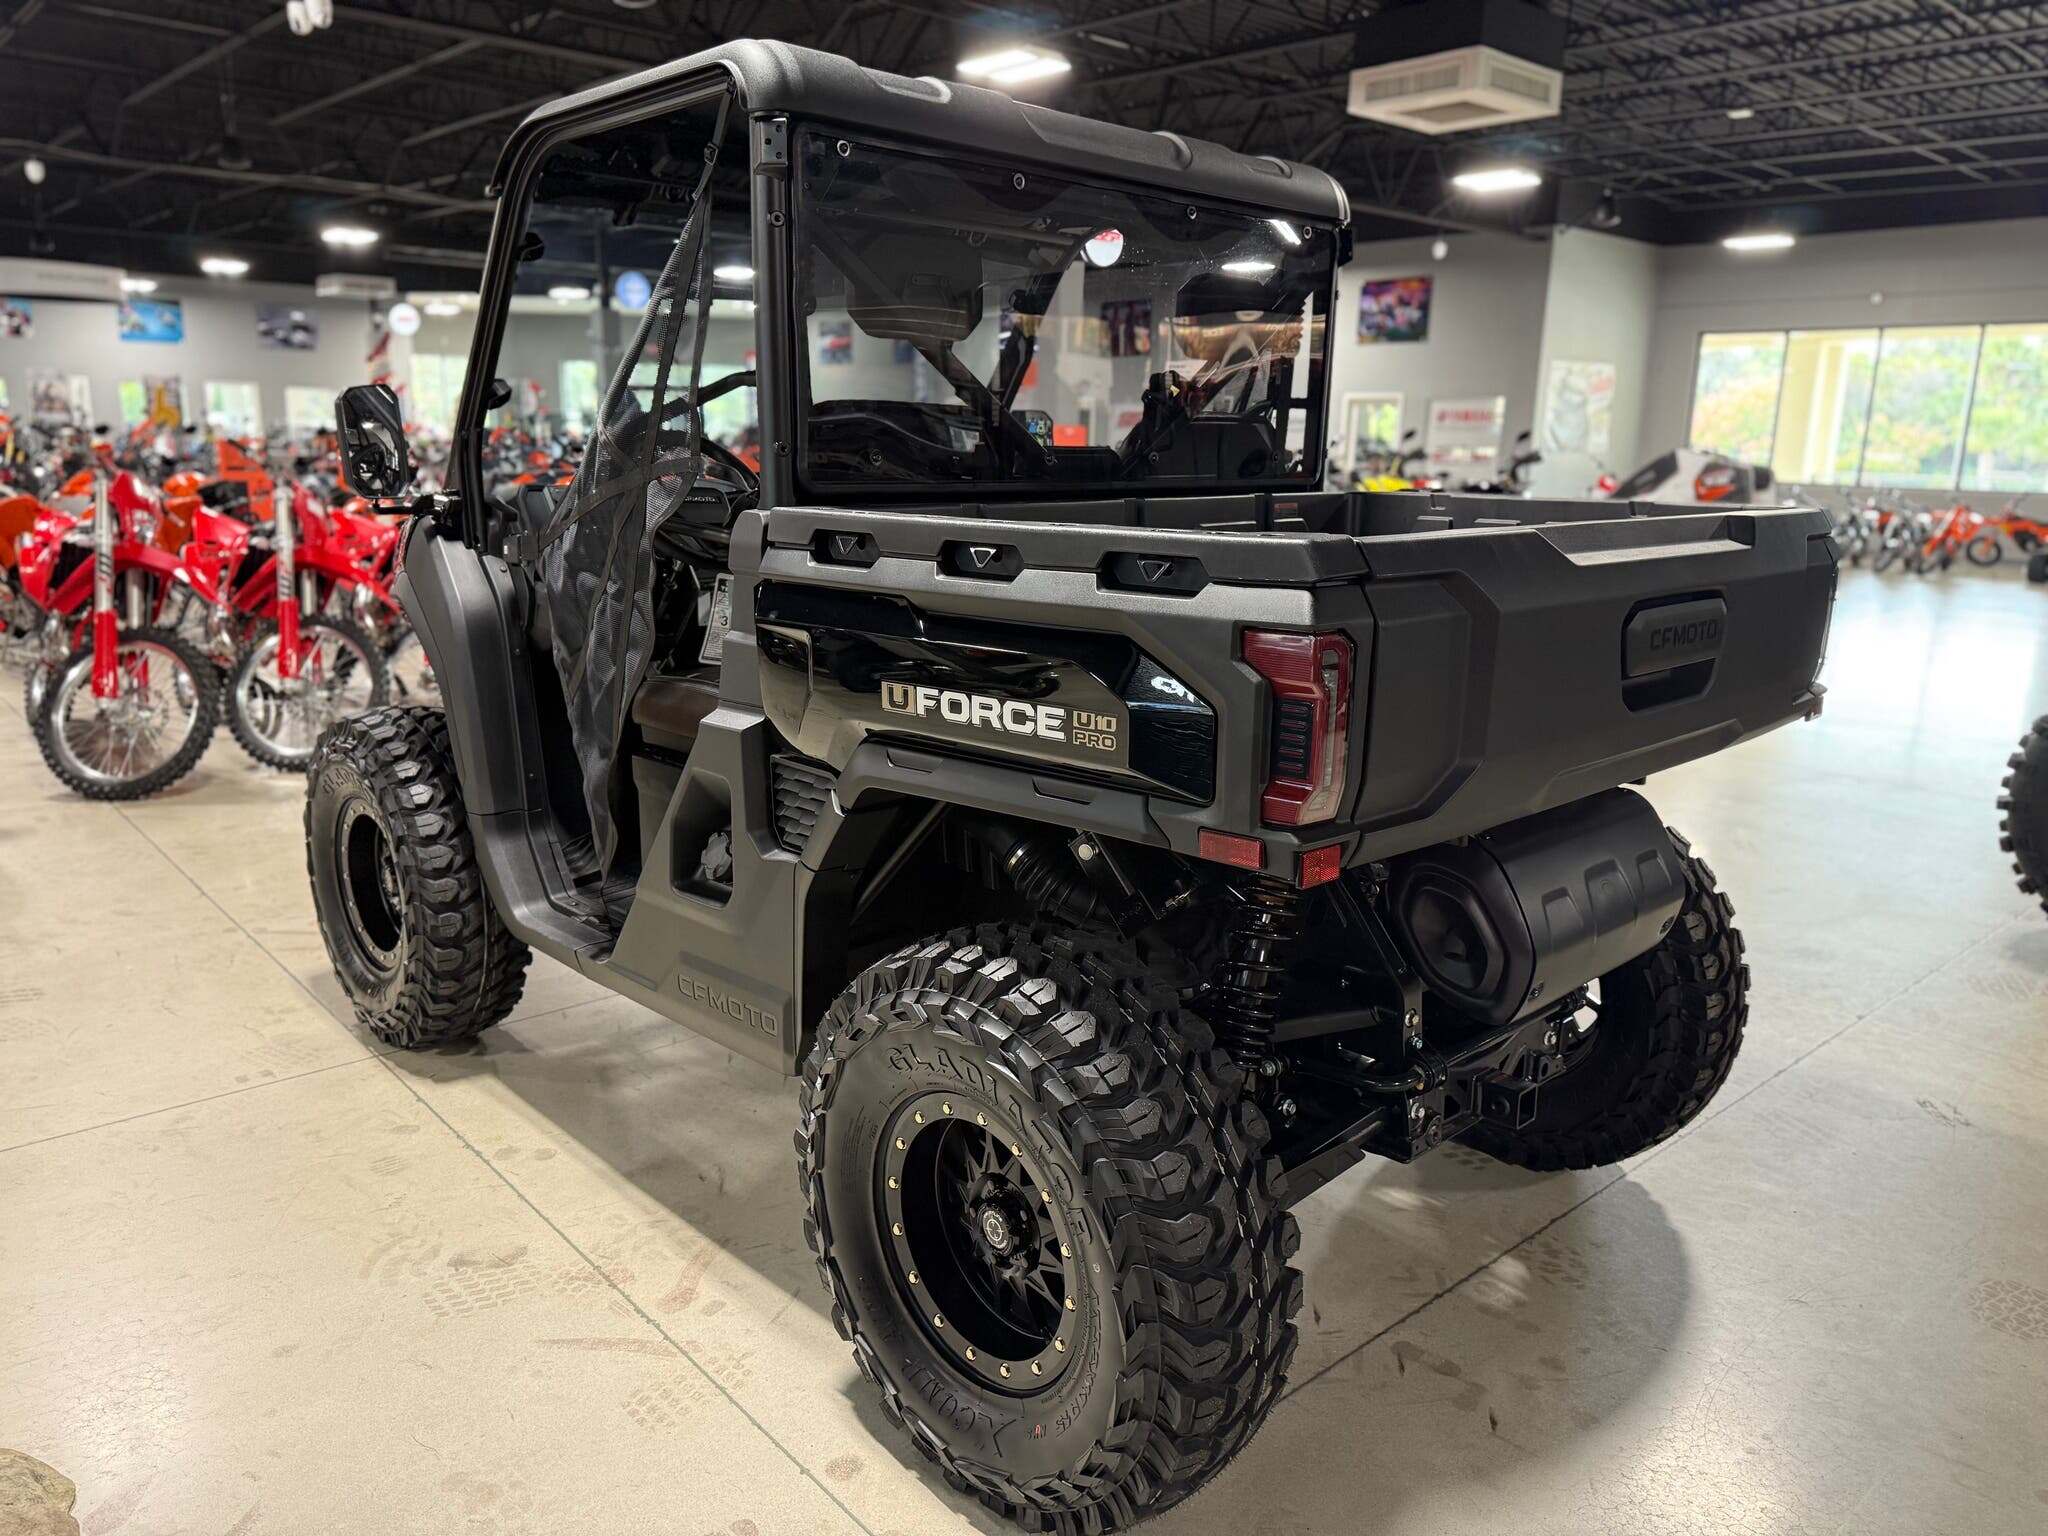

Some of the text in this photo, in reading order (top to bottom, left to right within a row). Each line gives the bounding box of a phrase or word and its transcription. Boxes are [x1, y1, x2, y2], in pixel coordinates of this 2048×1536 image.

[1650, 619, 1720, 651] CFMOTO
[1072, 710, 1118, 732] U10
[1072, 728, 1118, 751] PRO
[677, 974, 777, 1038] CFMOTO
